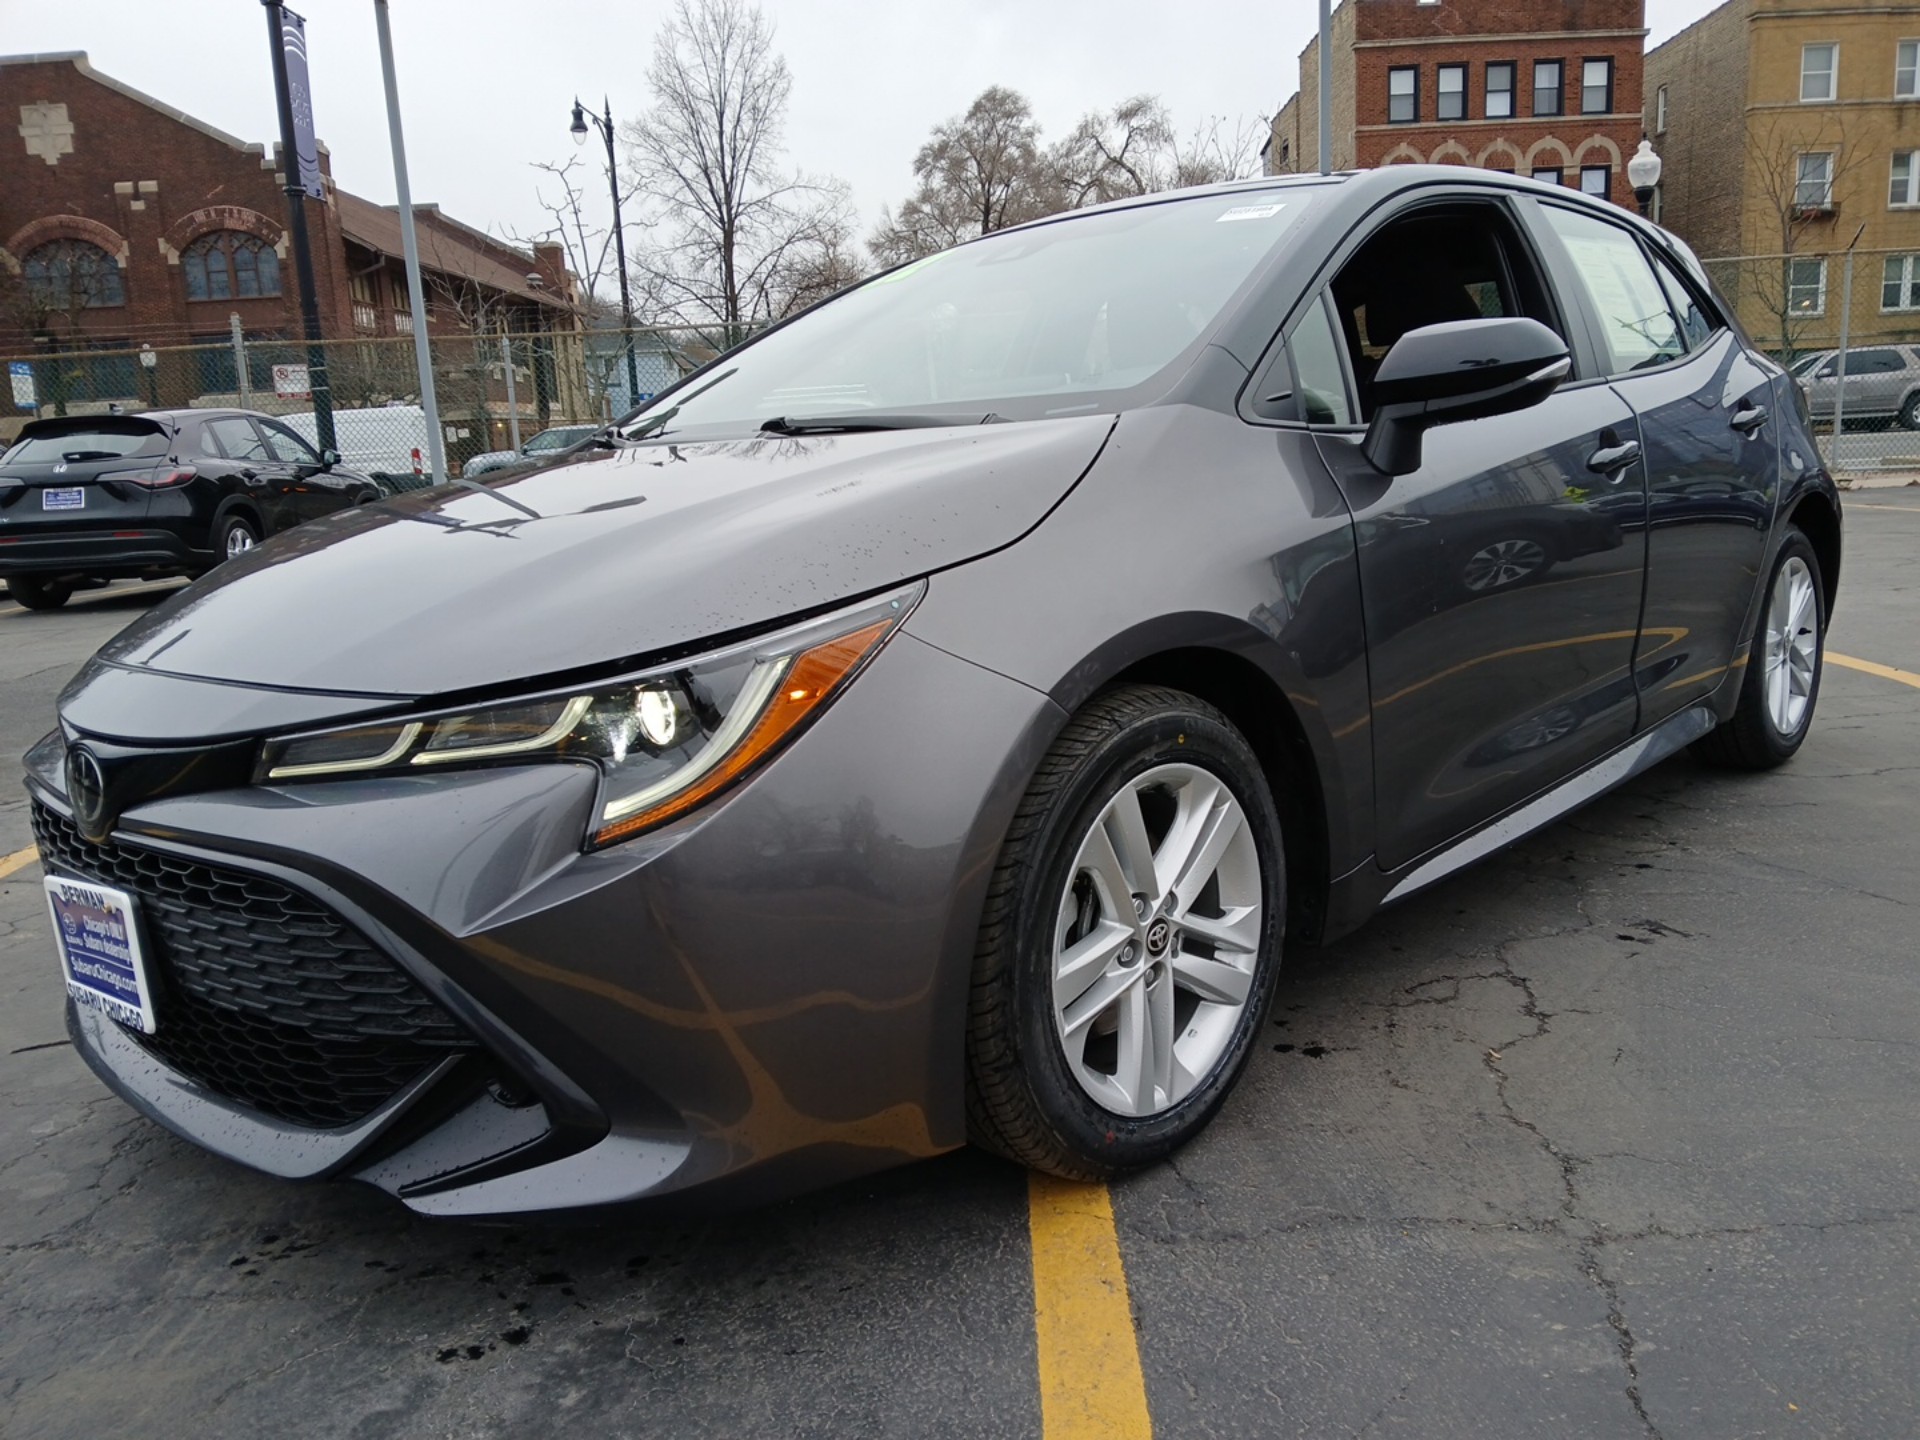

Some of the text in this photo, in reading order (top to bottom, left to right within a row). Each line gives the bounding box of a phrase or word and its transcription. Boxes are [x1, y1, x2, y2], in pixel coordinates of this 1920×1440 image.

[60, 884, 105, 910] BERMAN
[71, 955, 138, 993] SubaruChicago.com
[67, 982, 144, 1031] SUBARU CHICAGO
